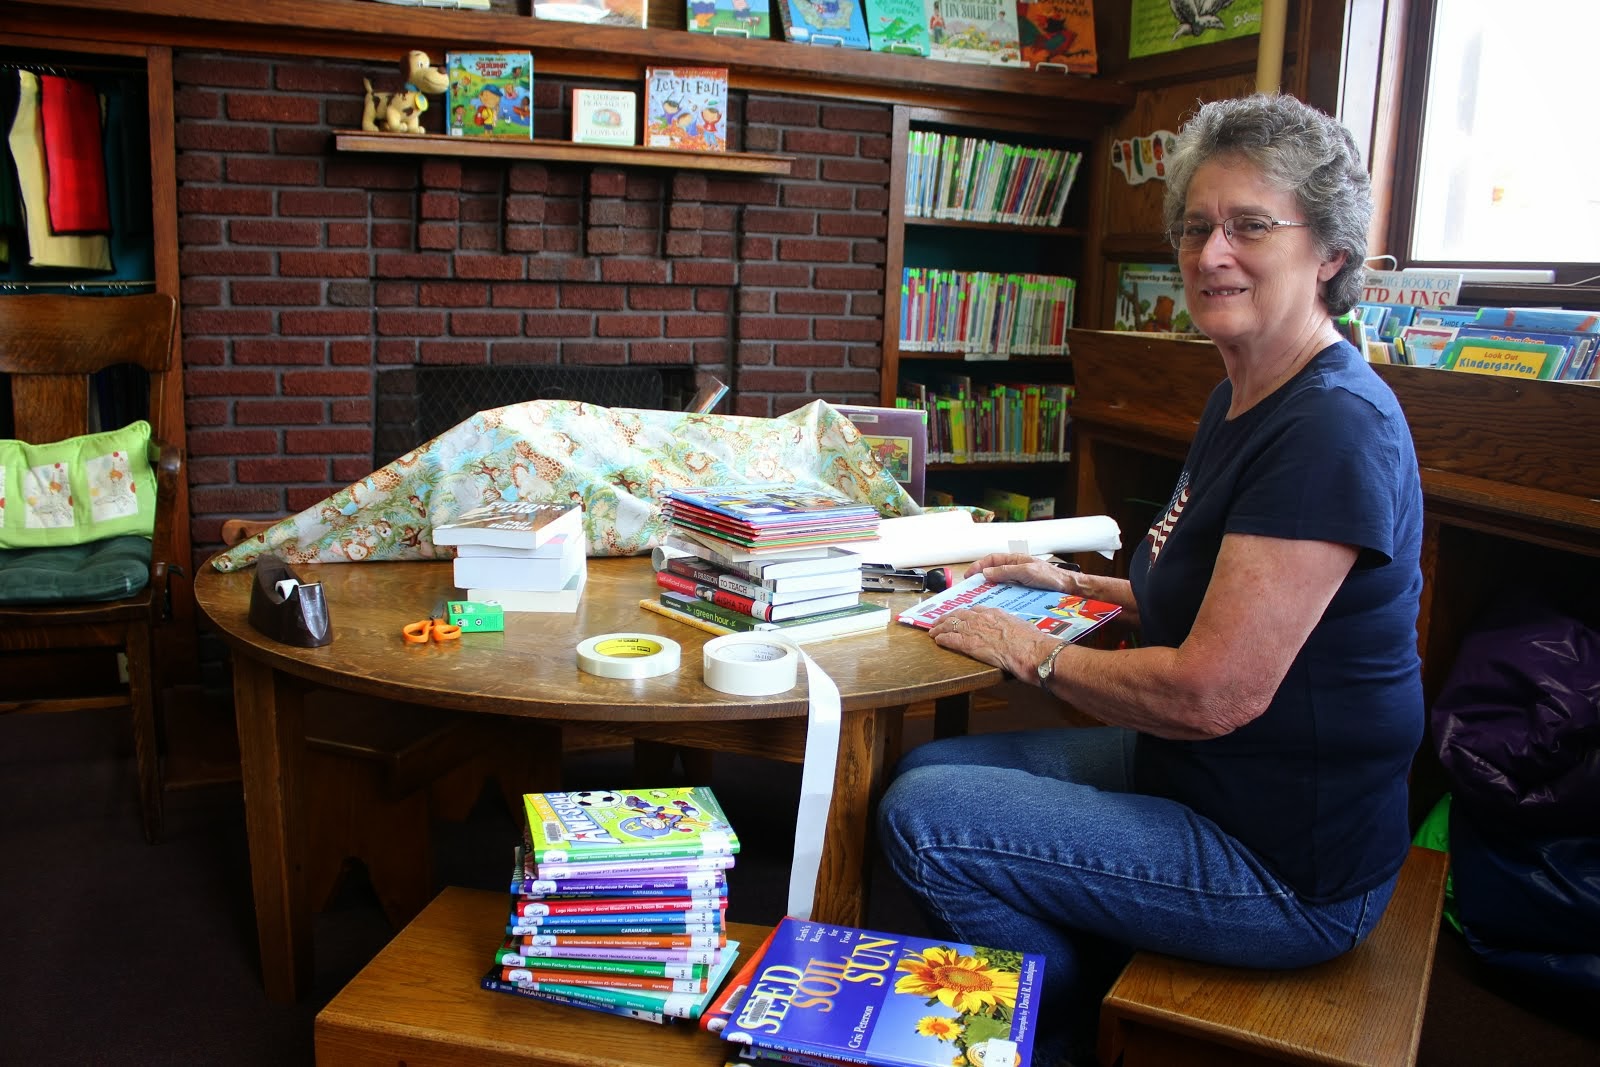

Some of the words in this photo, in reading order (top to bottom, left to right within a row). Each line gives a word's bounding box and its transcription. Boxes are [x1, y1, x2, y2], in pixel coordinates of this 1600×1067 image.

[962, 6, 998, 21] SOLDIER
[476, 62, 508, 71] Summer
[481, 69, 502, 77] Camp
[655, 78, 674, 92] Let
[681, 81, 691, 93] It
[696, 81, 720, 97] Fall
[1401, 276, 1433, 289] BOOK
[1437, 279, 1454, 290] OF
[1363, 287, 1451, 306] TRAINS
[693, 570, 698, 578] A
[698, 572, 719, 586] PASSION
[719, 578, 728, 588] TO
[728, 580, 749, 595] TEACH
[694, 608, 714, 621] green
[714, 612, 730, 625] hour
[737, 602, 752, 614] TYL
[547, 792, 624, 844] AWESOME
[796, 925, 812, 942] Earth's
[810, 927, 826, 943] Recipe
[827, 929, 839, 937] for
[840, 931, 853, 944] Food
[842, 933, 899, 987] SUN
[791, 956, 853, 1013] SOIL
[1021, 984, 1032, 993] R.
[523, 989, 542, 997] MAN
[545, 993, 571, 1003] STEEL
[736, 965, 804, 1035] SEED
[1018, 991, 1031, 1010] David
[853, 1005, 874, 1034] Peterson
[1019, 1007, 1030, 1016] by
[1015, 1014, 1029, 1043] Photographs
[848, 1031, 864, 1049] Cris
[853, 1058, 868, 1066] FOOD
